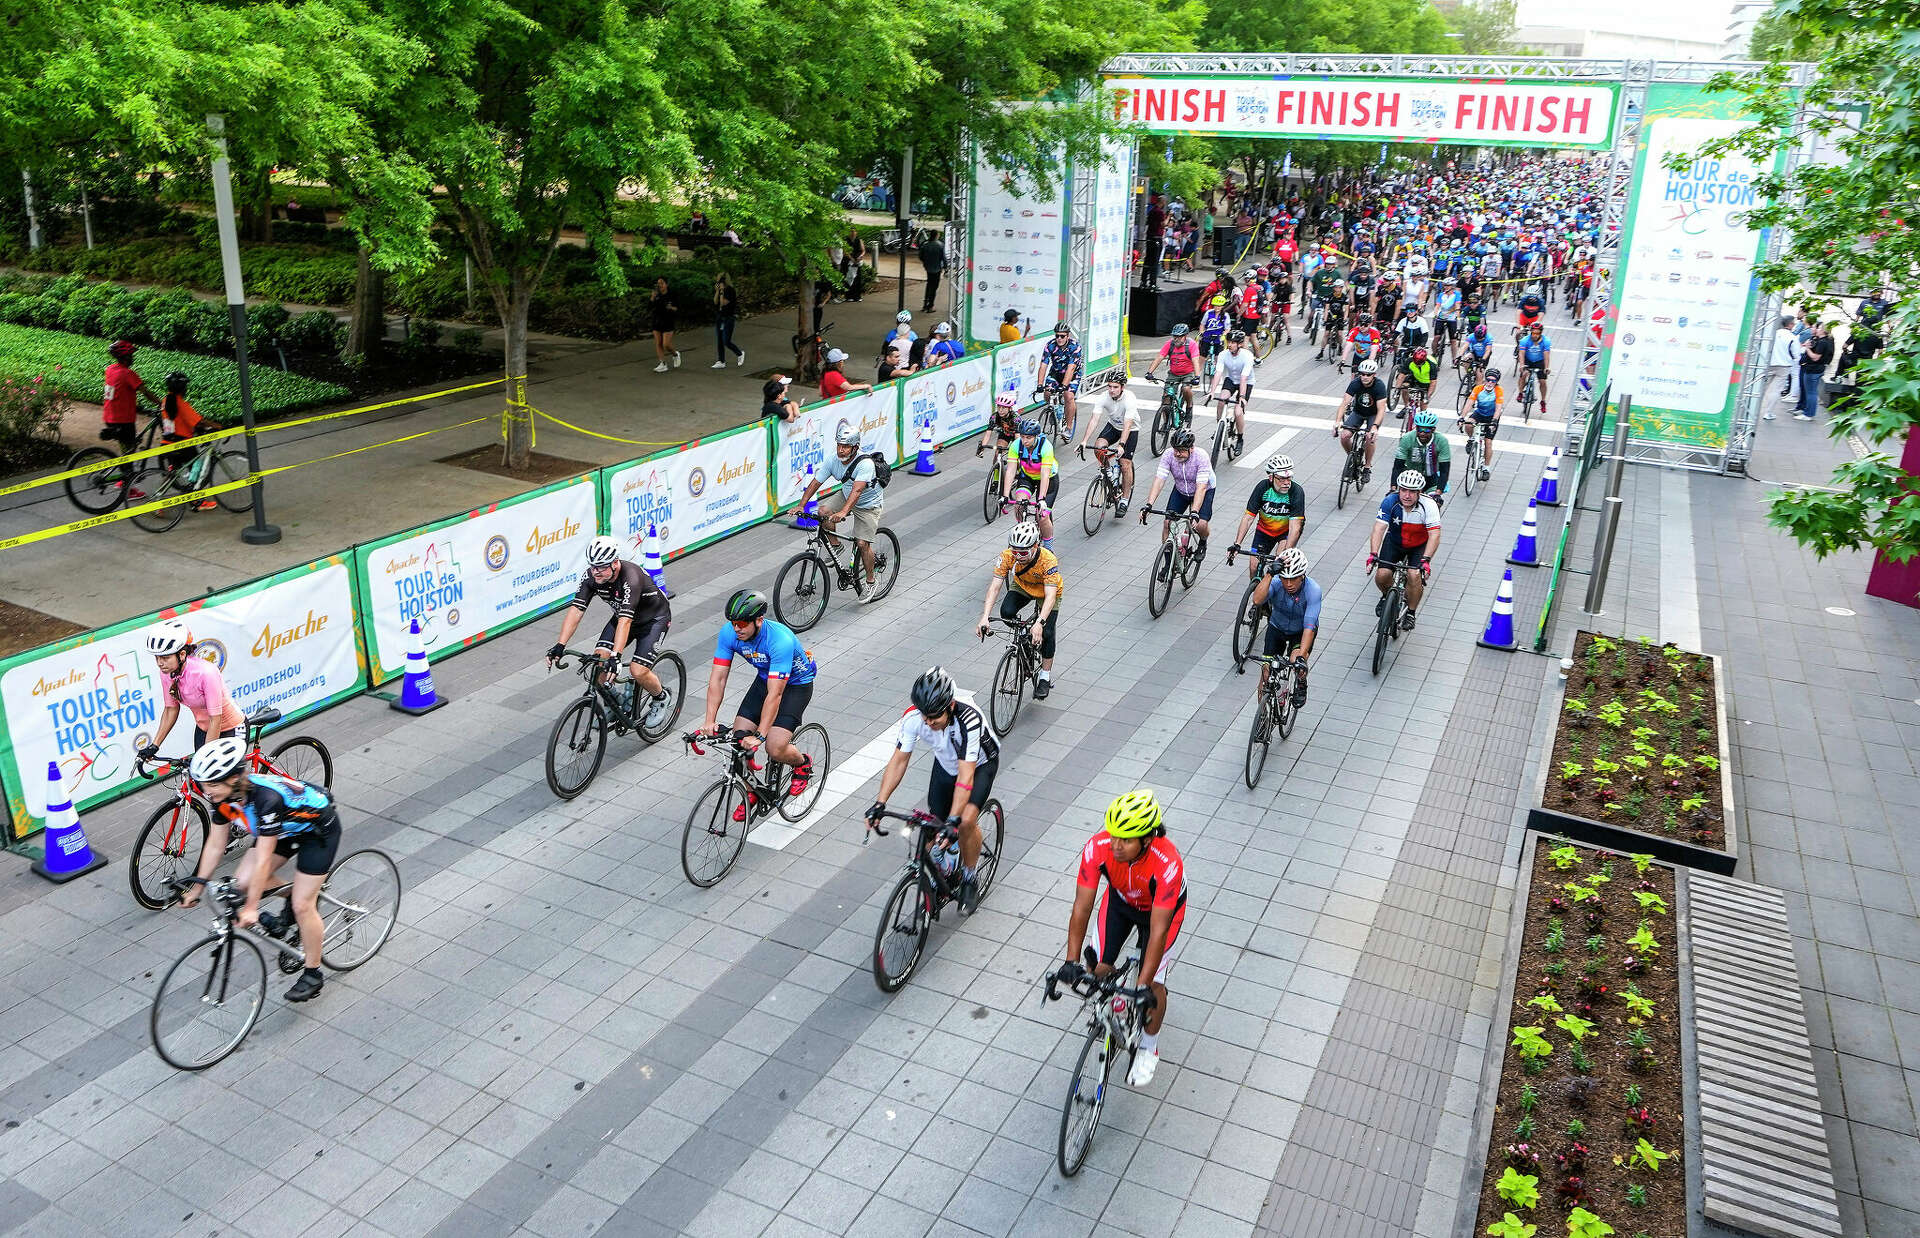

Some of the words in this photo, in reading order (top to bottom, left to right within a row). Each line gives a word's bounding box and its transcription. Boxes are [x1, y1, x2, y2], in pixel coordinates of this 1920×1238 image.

[1113, 88, 1226, 123] FINISH
[1277, 90, 1401, 127] FINISH
[1455, 94, 1592, 134] FINISH
[1727, 170, 1750, 183] de
[1664, 181, 1756, 206] HOUSTON
[789, 438, 811, 457] TOUR
[790, 448, 824, 474] HOUSTON
[716, 455, 756, 486] Apache
[627, 492, 655, 516] TOUR
[657, 496, 668, 507] de
[629, 503, 673, 535] HOUSTON
[526, 516, 581, 555] Apache
[385, 552, 421, 575] Apache
[511, 559, 561, 589] #TOURDEHOU
[394, 570, 435, 601] TOUR
[440, 572, 456, 586] de
[495, 572, 578, 612] www.TourDeHouston.org
[399, 581, 464, 623] HOUSTON
[250, 608, 329, 659] Apache
[31, 668, 87, 697] Apache
[231, 662, 302, 699] #TOURDEHOU
[241, 674, 327, 716] ourDeHouston.org
[46, 687, 112, 729] TOUR
[118, 688, 144, 706] de
[55, 697, 156, 756] HOUSTON
